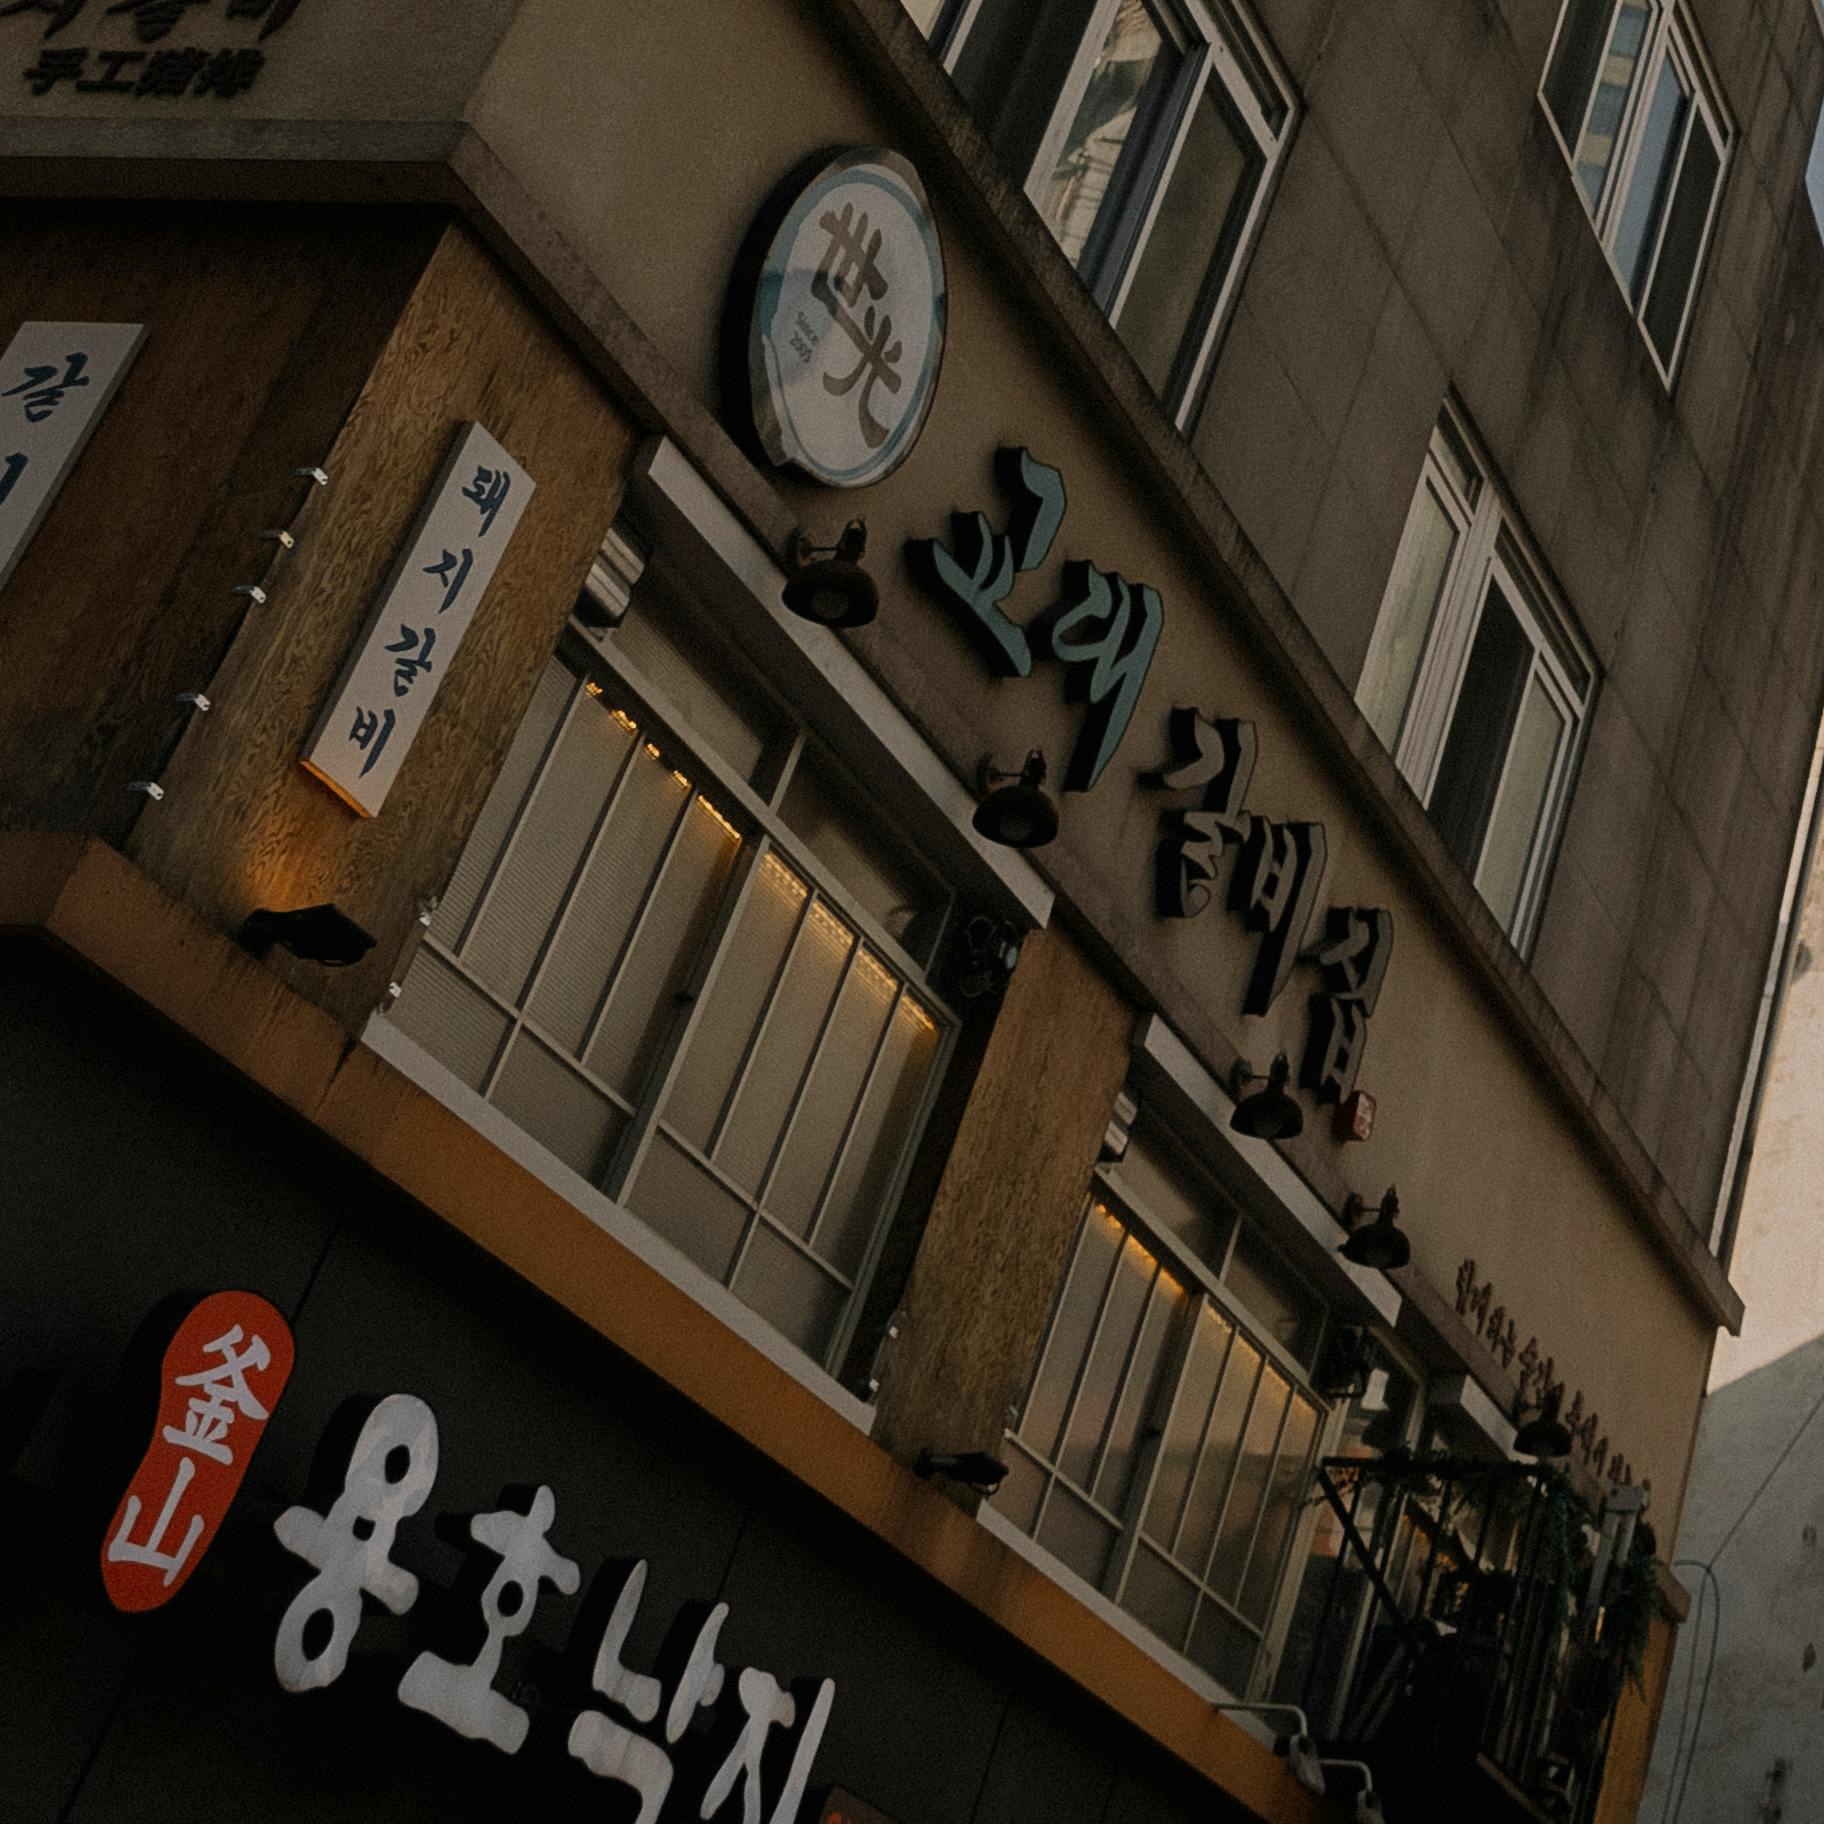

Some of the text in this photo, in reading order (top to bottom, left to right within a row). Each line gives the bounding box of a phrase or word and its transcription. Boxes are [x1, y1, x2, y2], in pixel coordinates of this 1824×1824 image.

[350, 464, 511, 778] 돼지갈비
[107, 1323, 272, 1587] 釜山
[273, 1393, 836, 1824] 용호낙지
